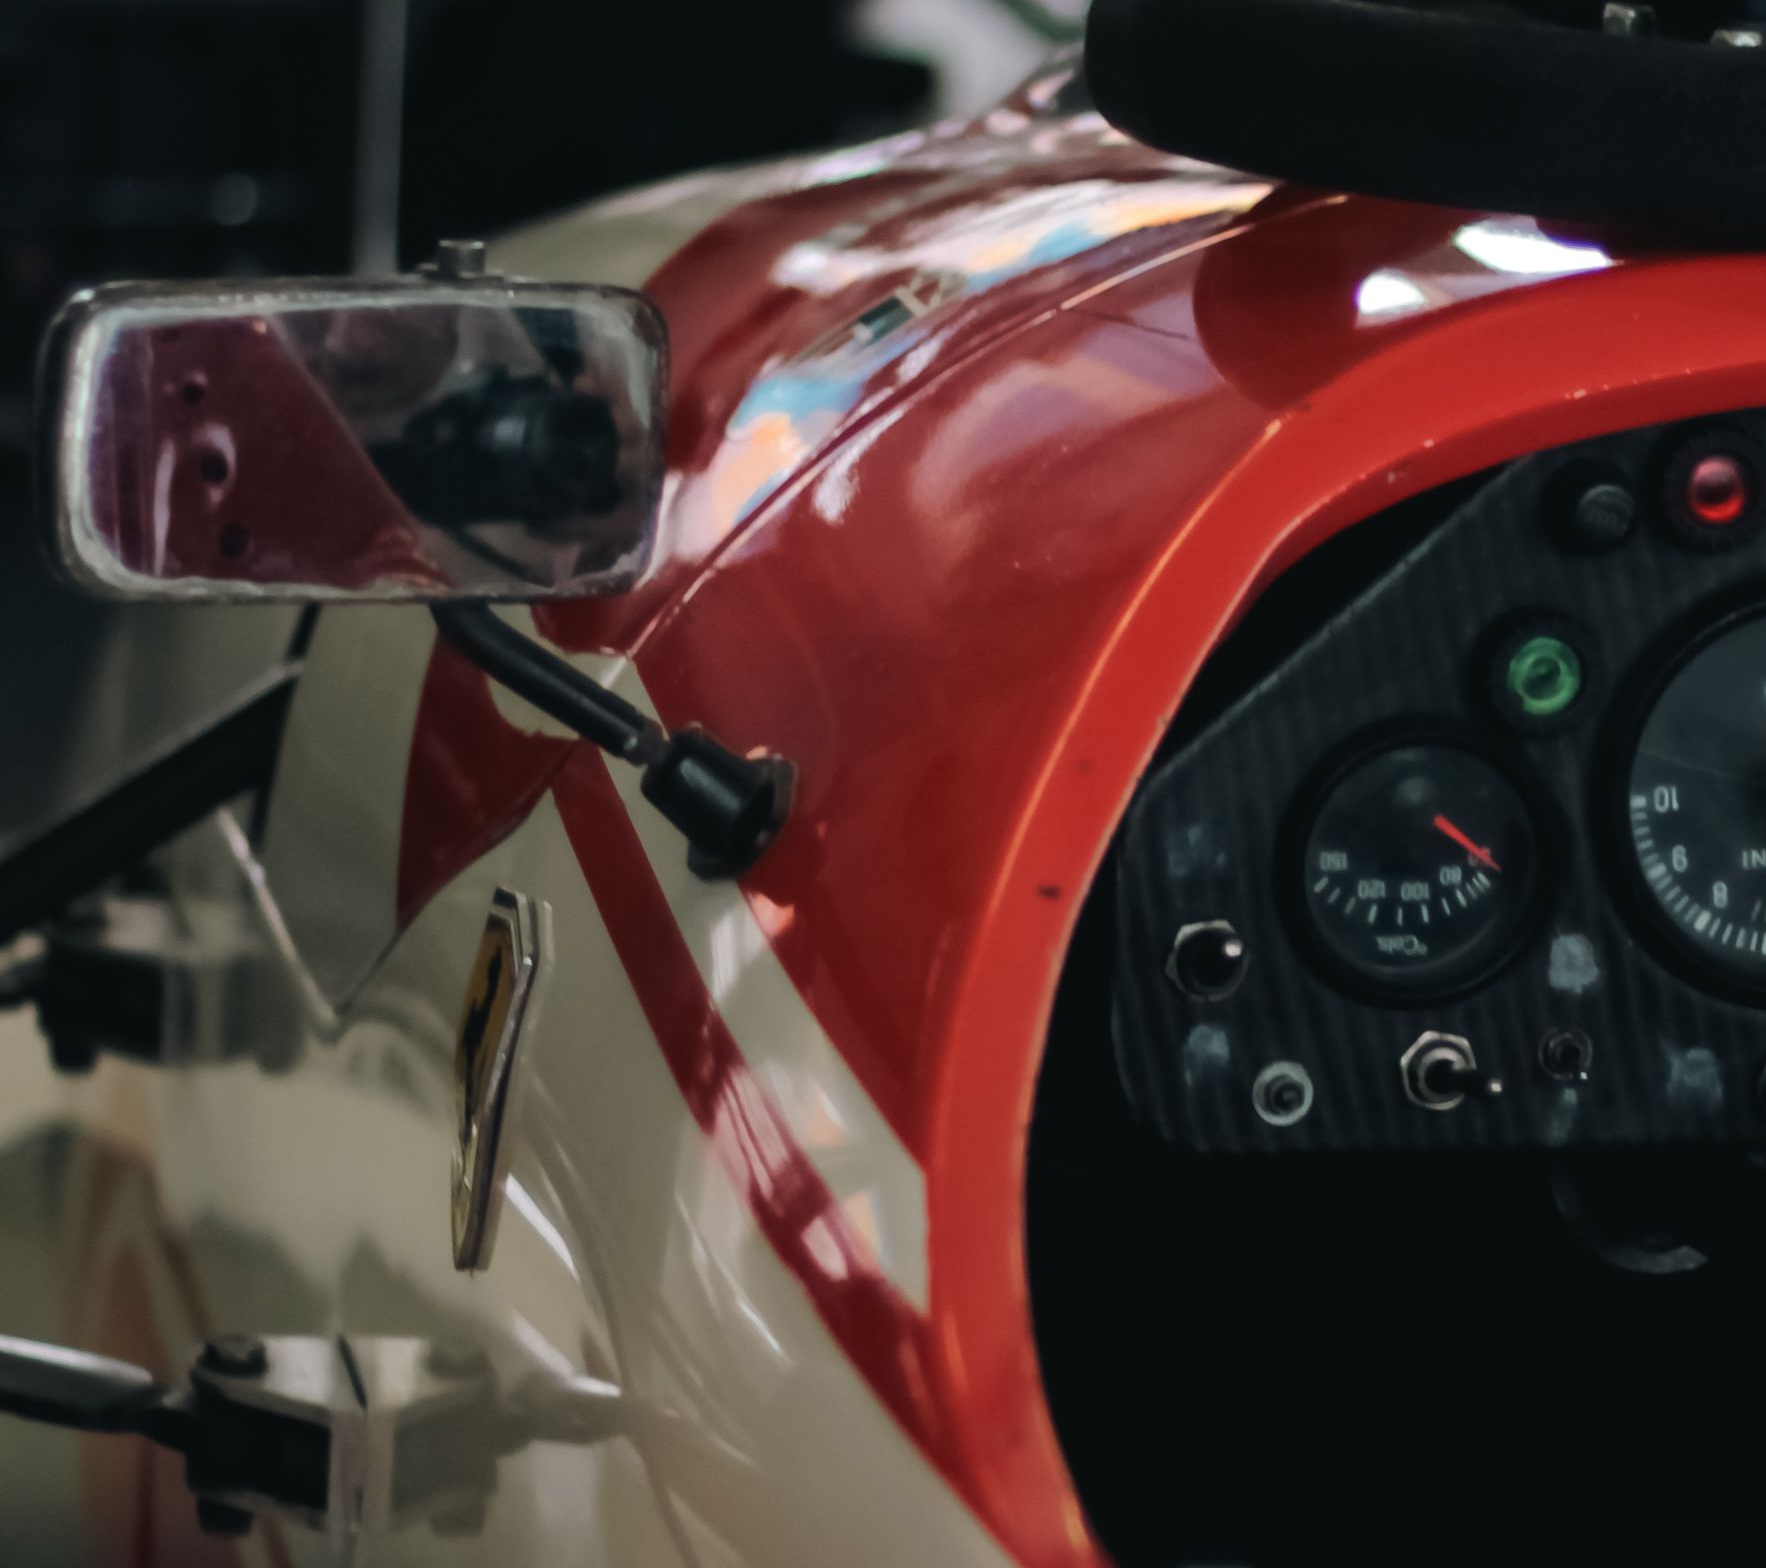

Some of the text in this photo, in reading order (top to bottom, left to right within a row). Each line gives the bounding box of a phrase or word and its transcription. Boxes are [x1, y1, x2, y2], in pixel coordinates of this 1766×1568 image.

[1653, 786, 1680, 812] 10
[1671, 845, 1688, 872] 9
[1439, 865, 1463, 885] 80
[1357, 879, 1386, 900] 120
[1400, 880, 1431, 901] 100
[1712, 880, 1729, 908] 8
